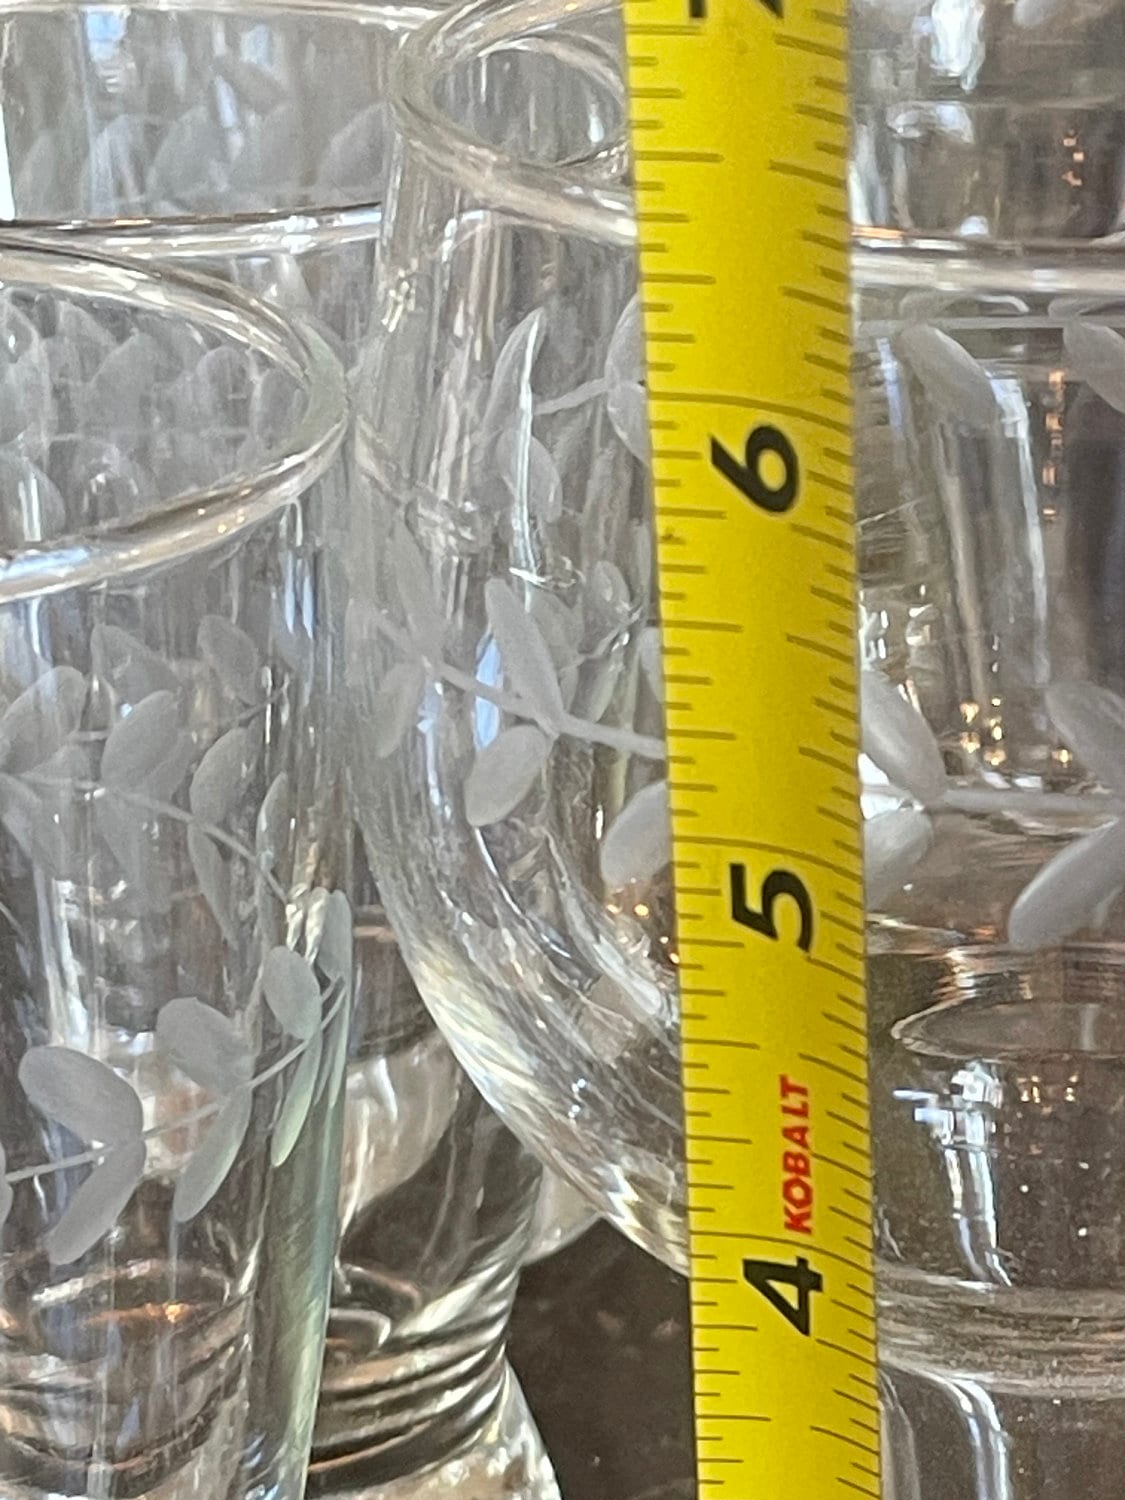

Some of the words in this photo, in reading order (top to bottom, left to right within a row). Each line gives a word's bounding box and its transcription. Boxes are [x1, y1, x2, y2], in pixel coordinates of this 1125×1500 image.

[709, 424, 800, 513] 6
[729, 863, 814, 953] 5
[780, 1074, 814, 1235] KOBALT
[743, 1256, 823, 1337] 4
